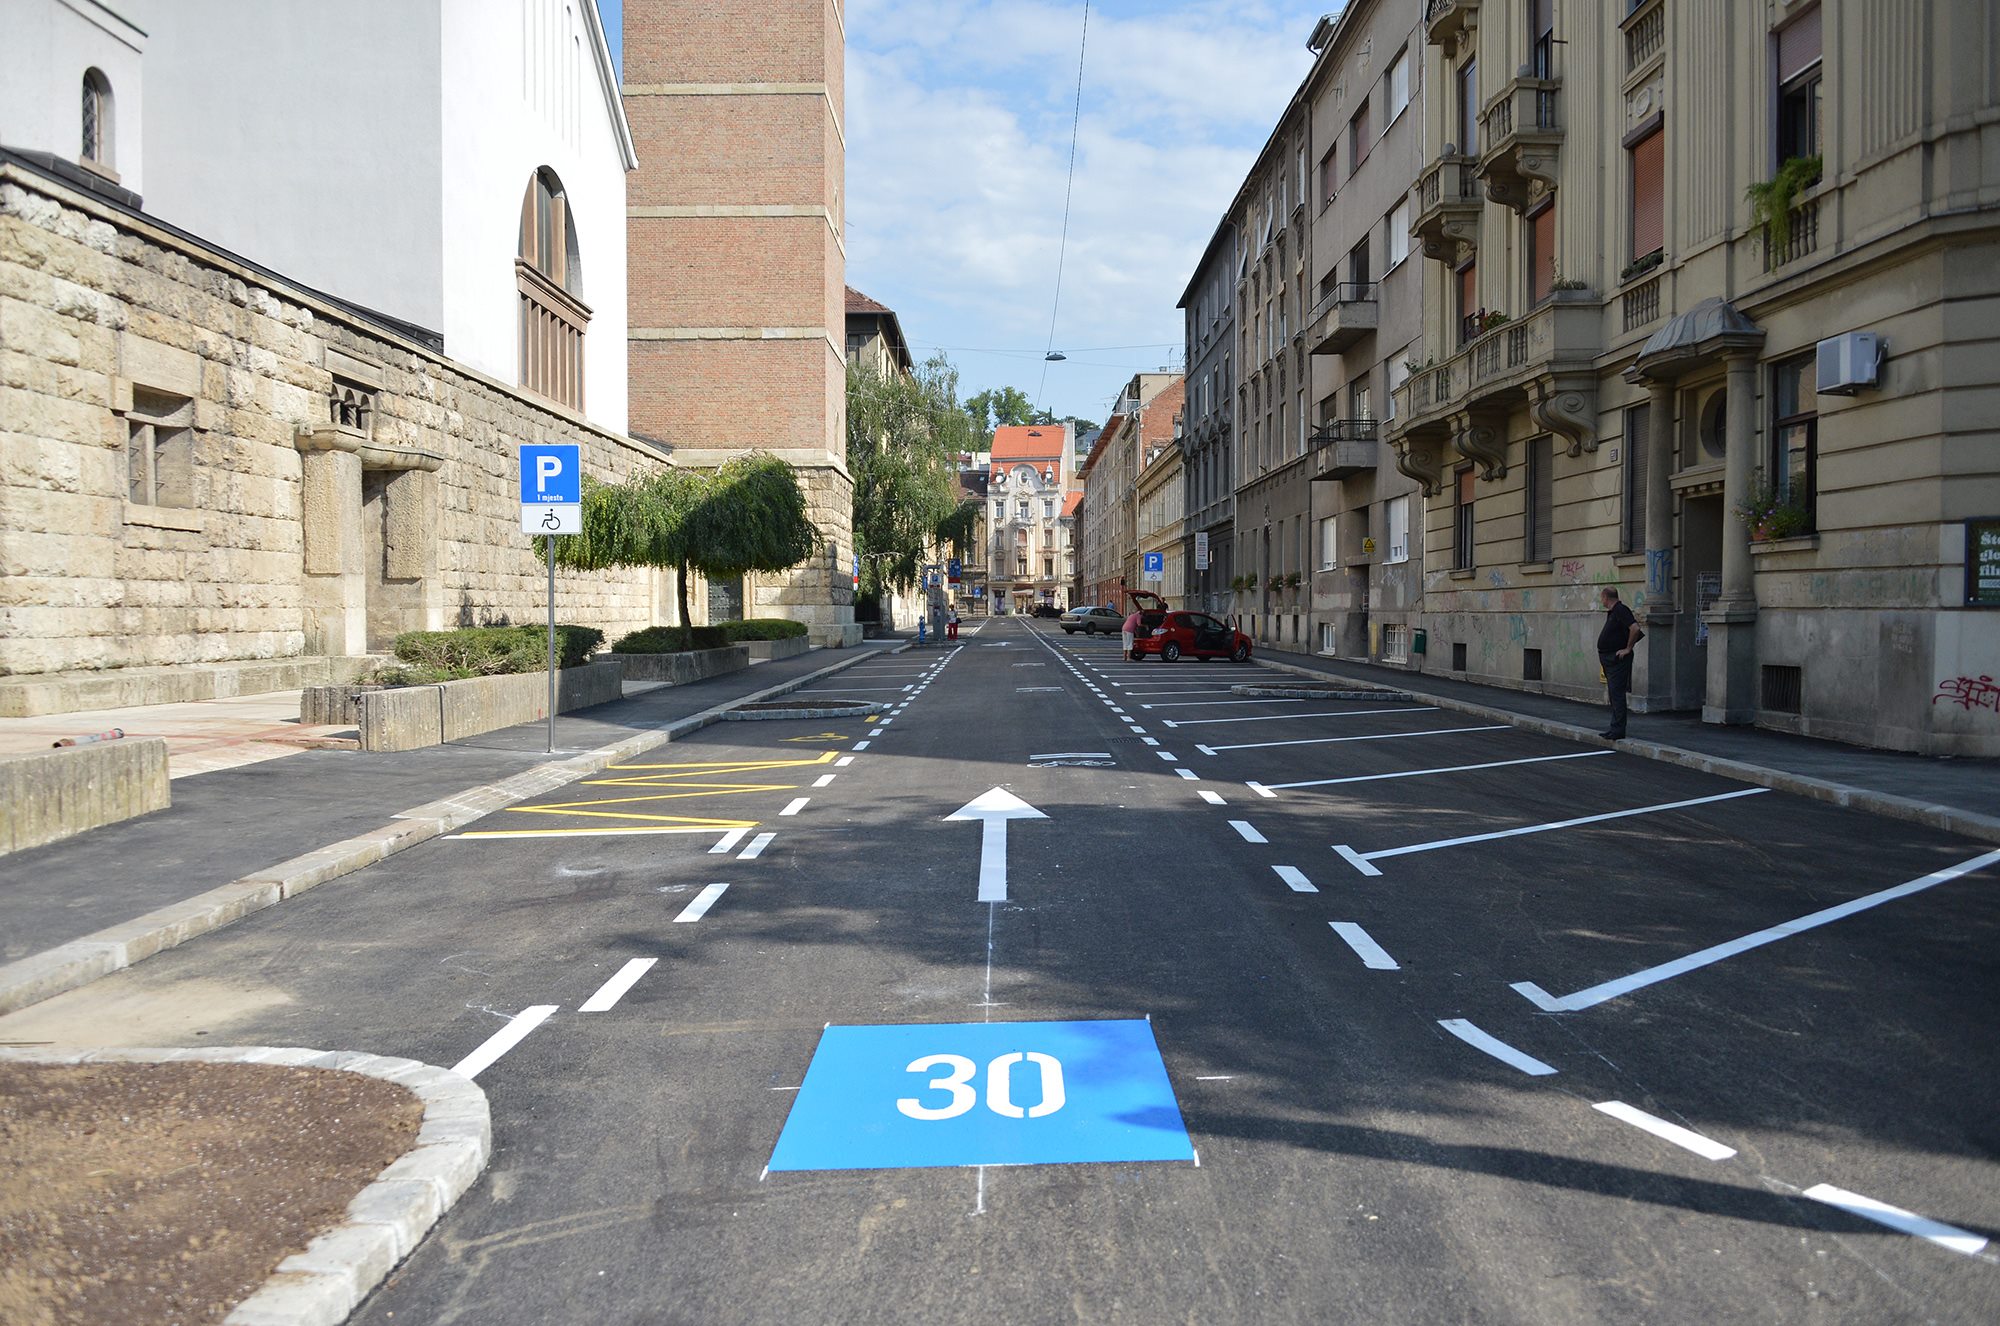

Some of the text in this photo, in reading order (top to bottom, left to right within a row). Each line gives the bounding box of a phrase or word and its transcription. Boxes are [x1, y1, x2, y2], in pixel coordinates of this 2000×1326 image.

[536, 455, 563, 492] P
[542, 493, 564, 502] mjesto
[1149, 556, 1158, 568] P
[896, 1052, 1066, 1120] 30
